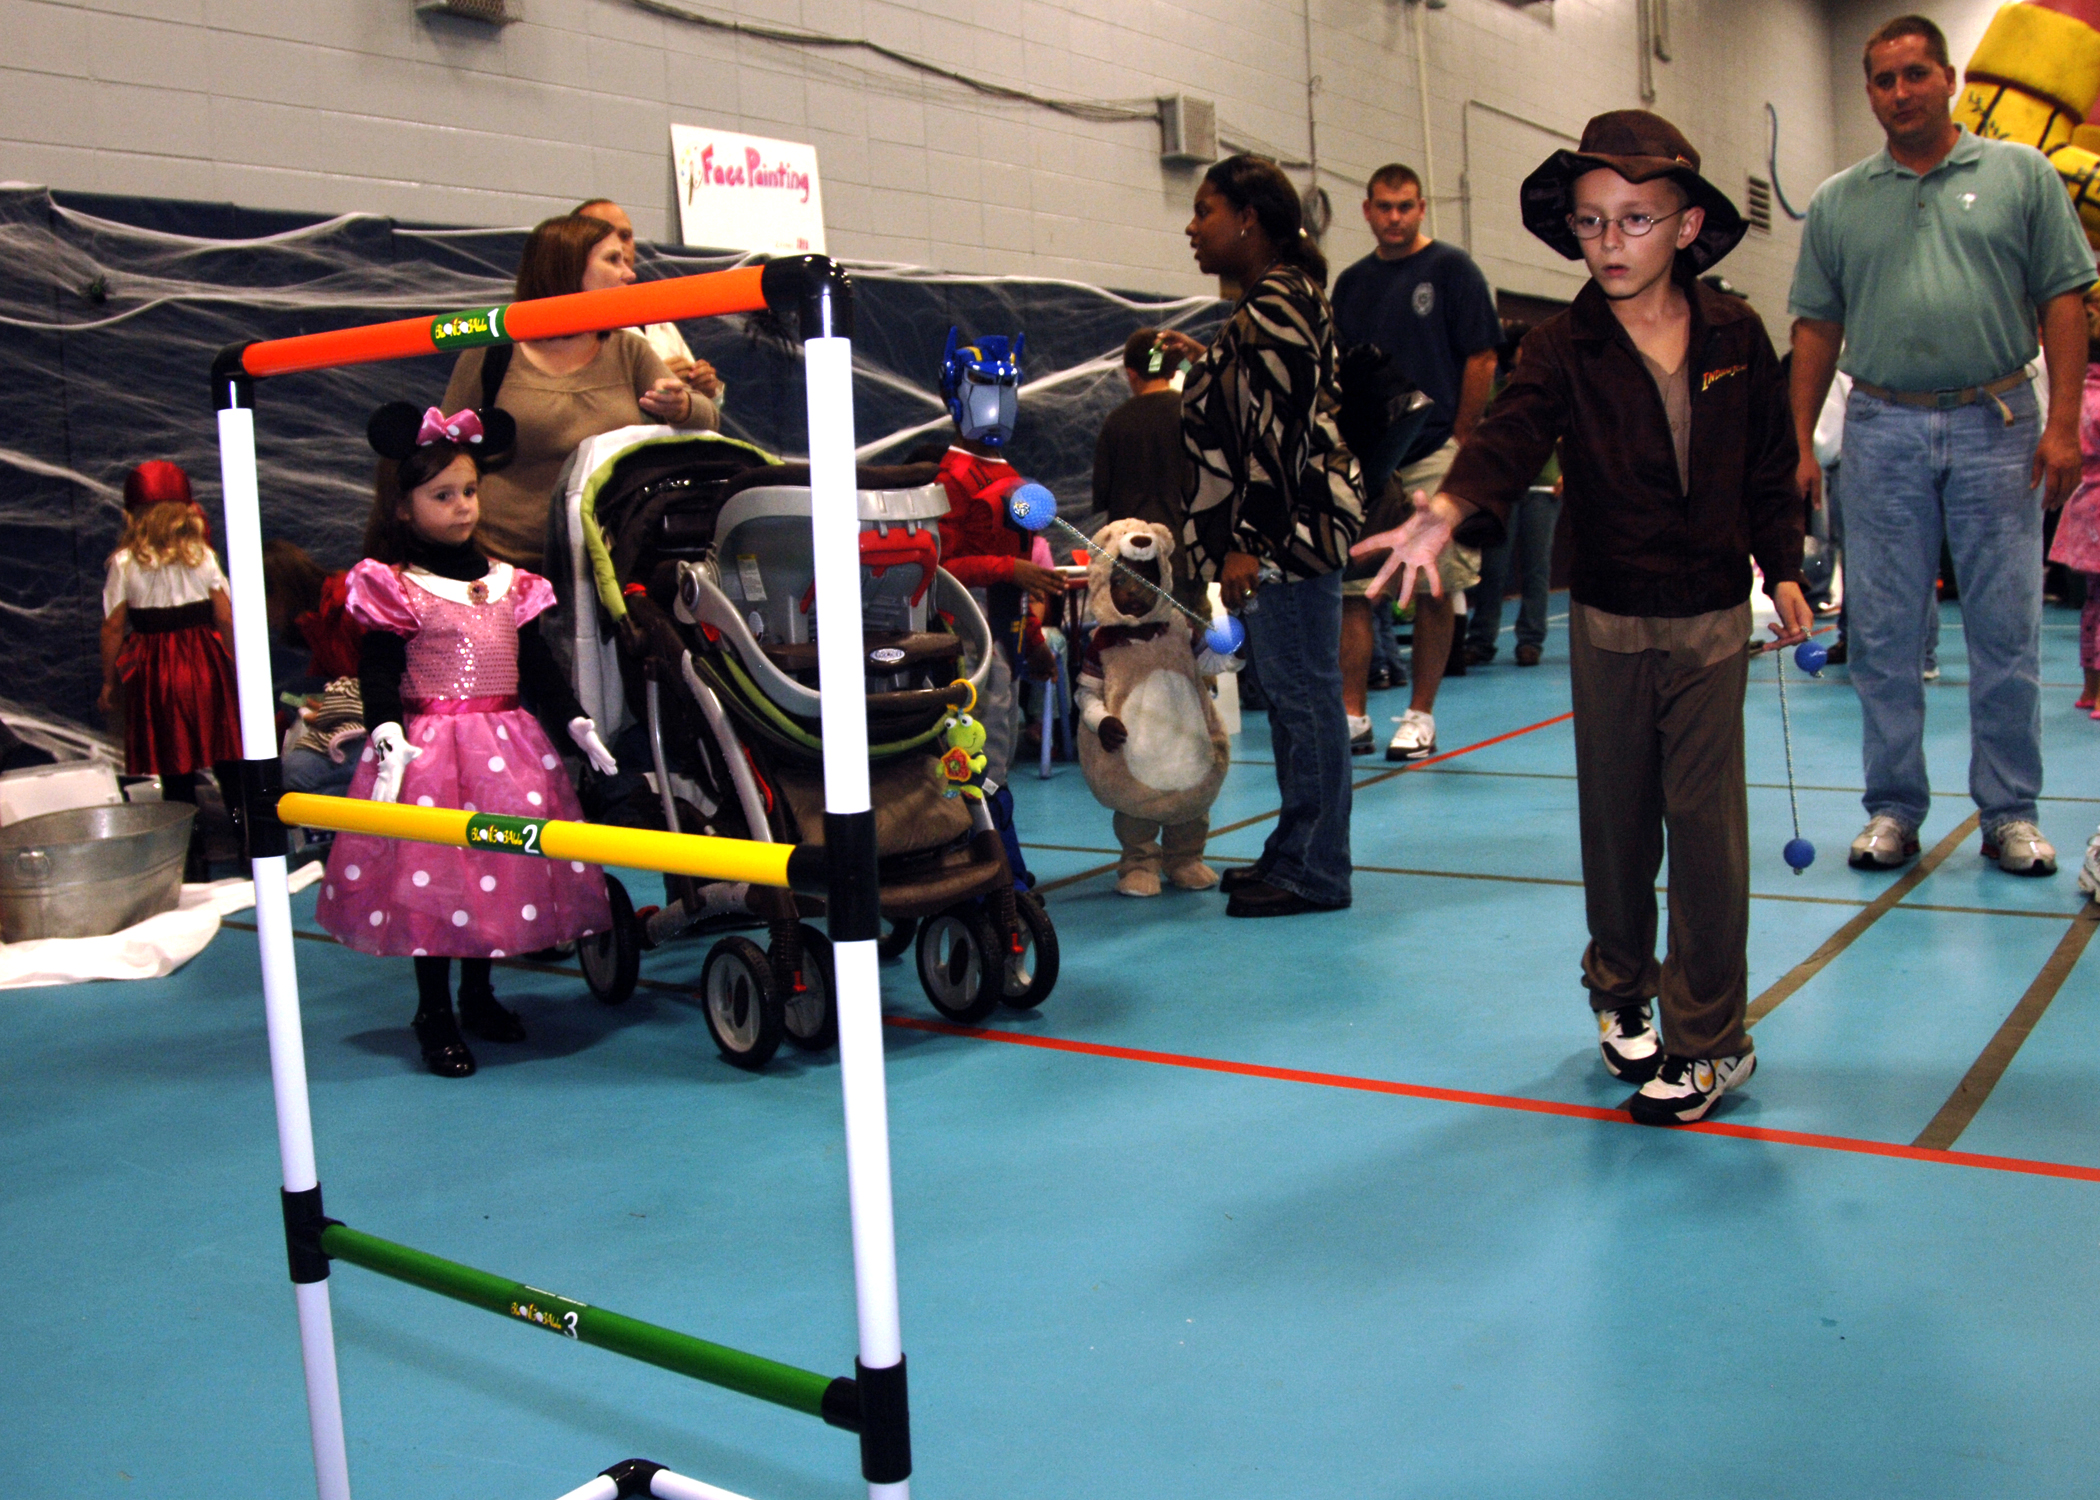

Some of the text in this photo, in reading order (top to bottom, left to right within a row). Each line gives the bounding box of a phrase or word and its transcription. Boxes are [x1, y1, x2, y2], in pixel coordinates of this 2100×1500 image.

[701, 143, 810, 204] Face Painting
[487, 308, 500, 338] 1
[522, 824, 539, 855] 2
[563, 1311, 579, 1341] 3
